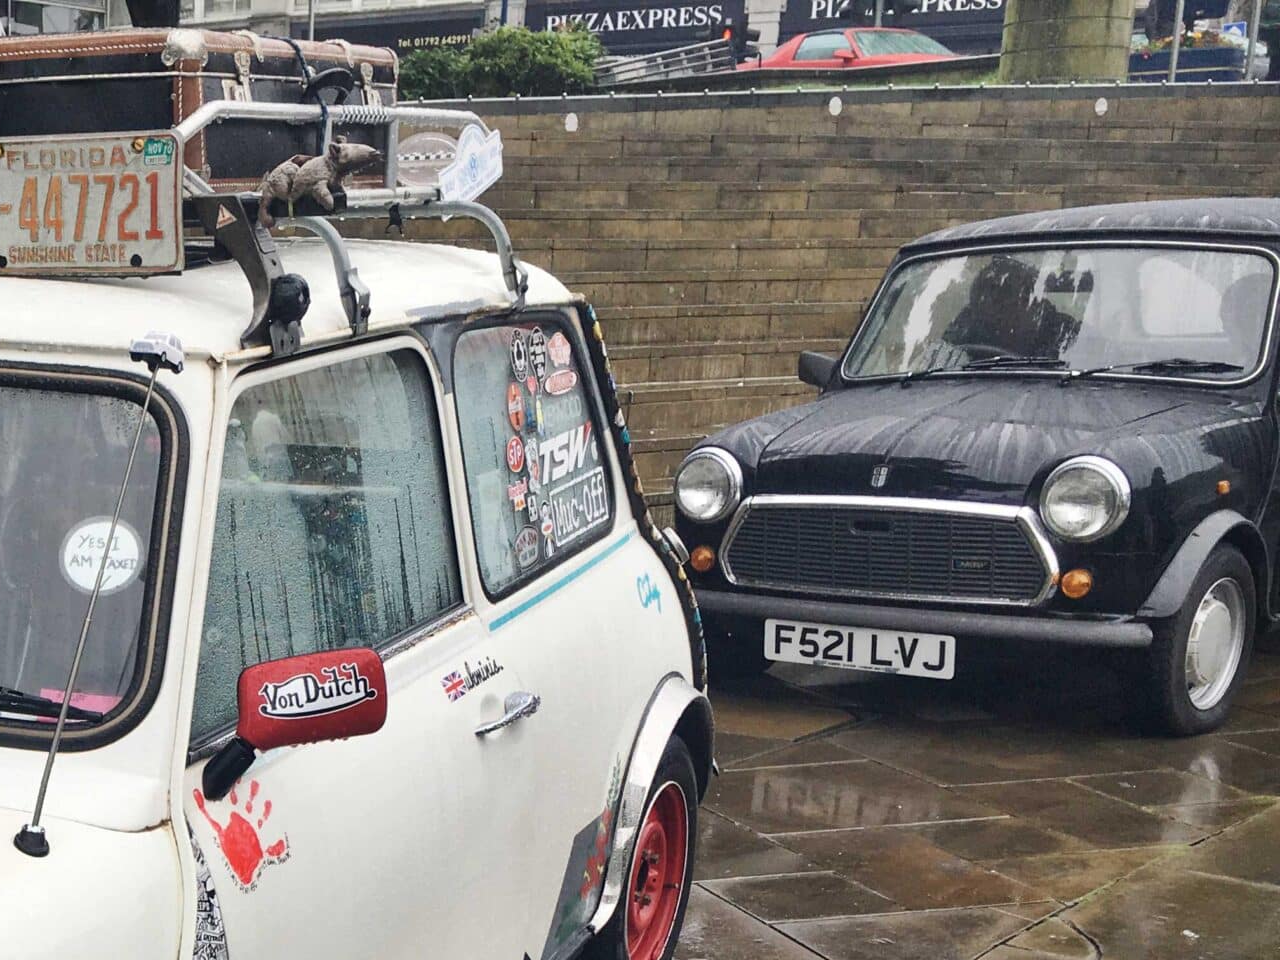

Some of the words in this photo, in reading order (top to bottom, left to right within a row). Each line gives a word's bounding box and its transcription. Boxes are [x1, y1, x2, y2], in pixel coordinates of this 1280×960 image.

[546, 5, 723, 32] PIZZAEXPRESS
[810, 0, 1002, 19] PIZPRESS
[6, 145, 128, 171] FLORIDA
[8, 245, 77, 265] SUNSHINE
[84, 243, 128, 263] STATE
[509, 440, 522, 469] STP
[539, 421, 593, 486] TSW
[554, 474, 605, 537] Muc-Off
[78, 534, 106, 549] YES
[69, 553, 93, 568] AM
[774, 624, 855, 663] F521
[870, 633, 947, 672] LVJ
[261, 682, 304, 712] Von
[304, 663, 377, 704] Dutch
